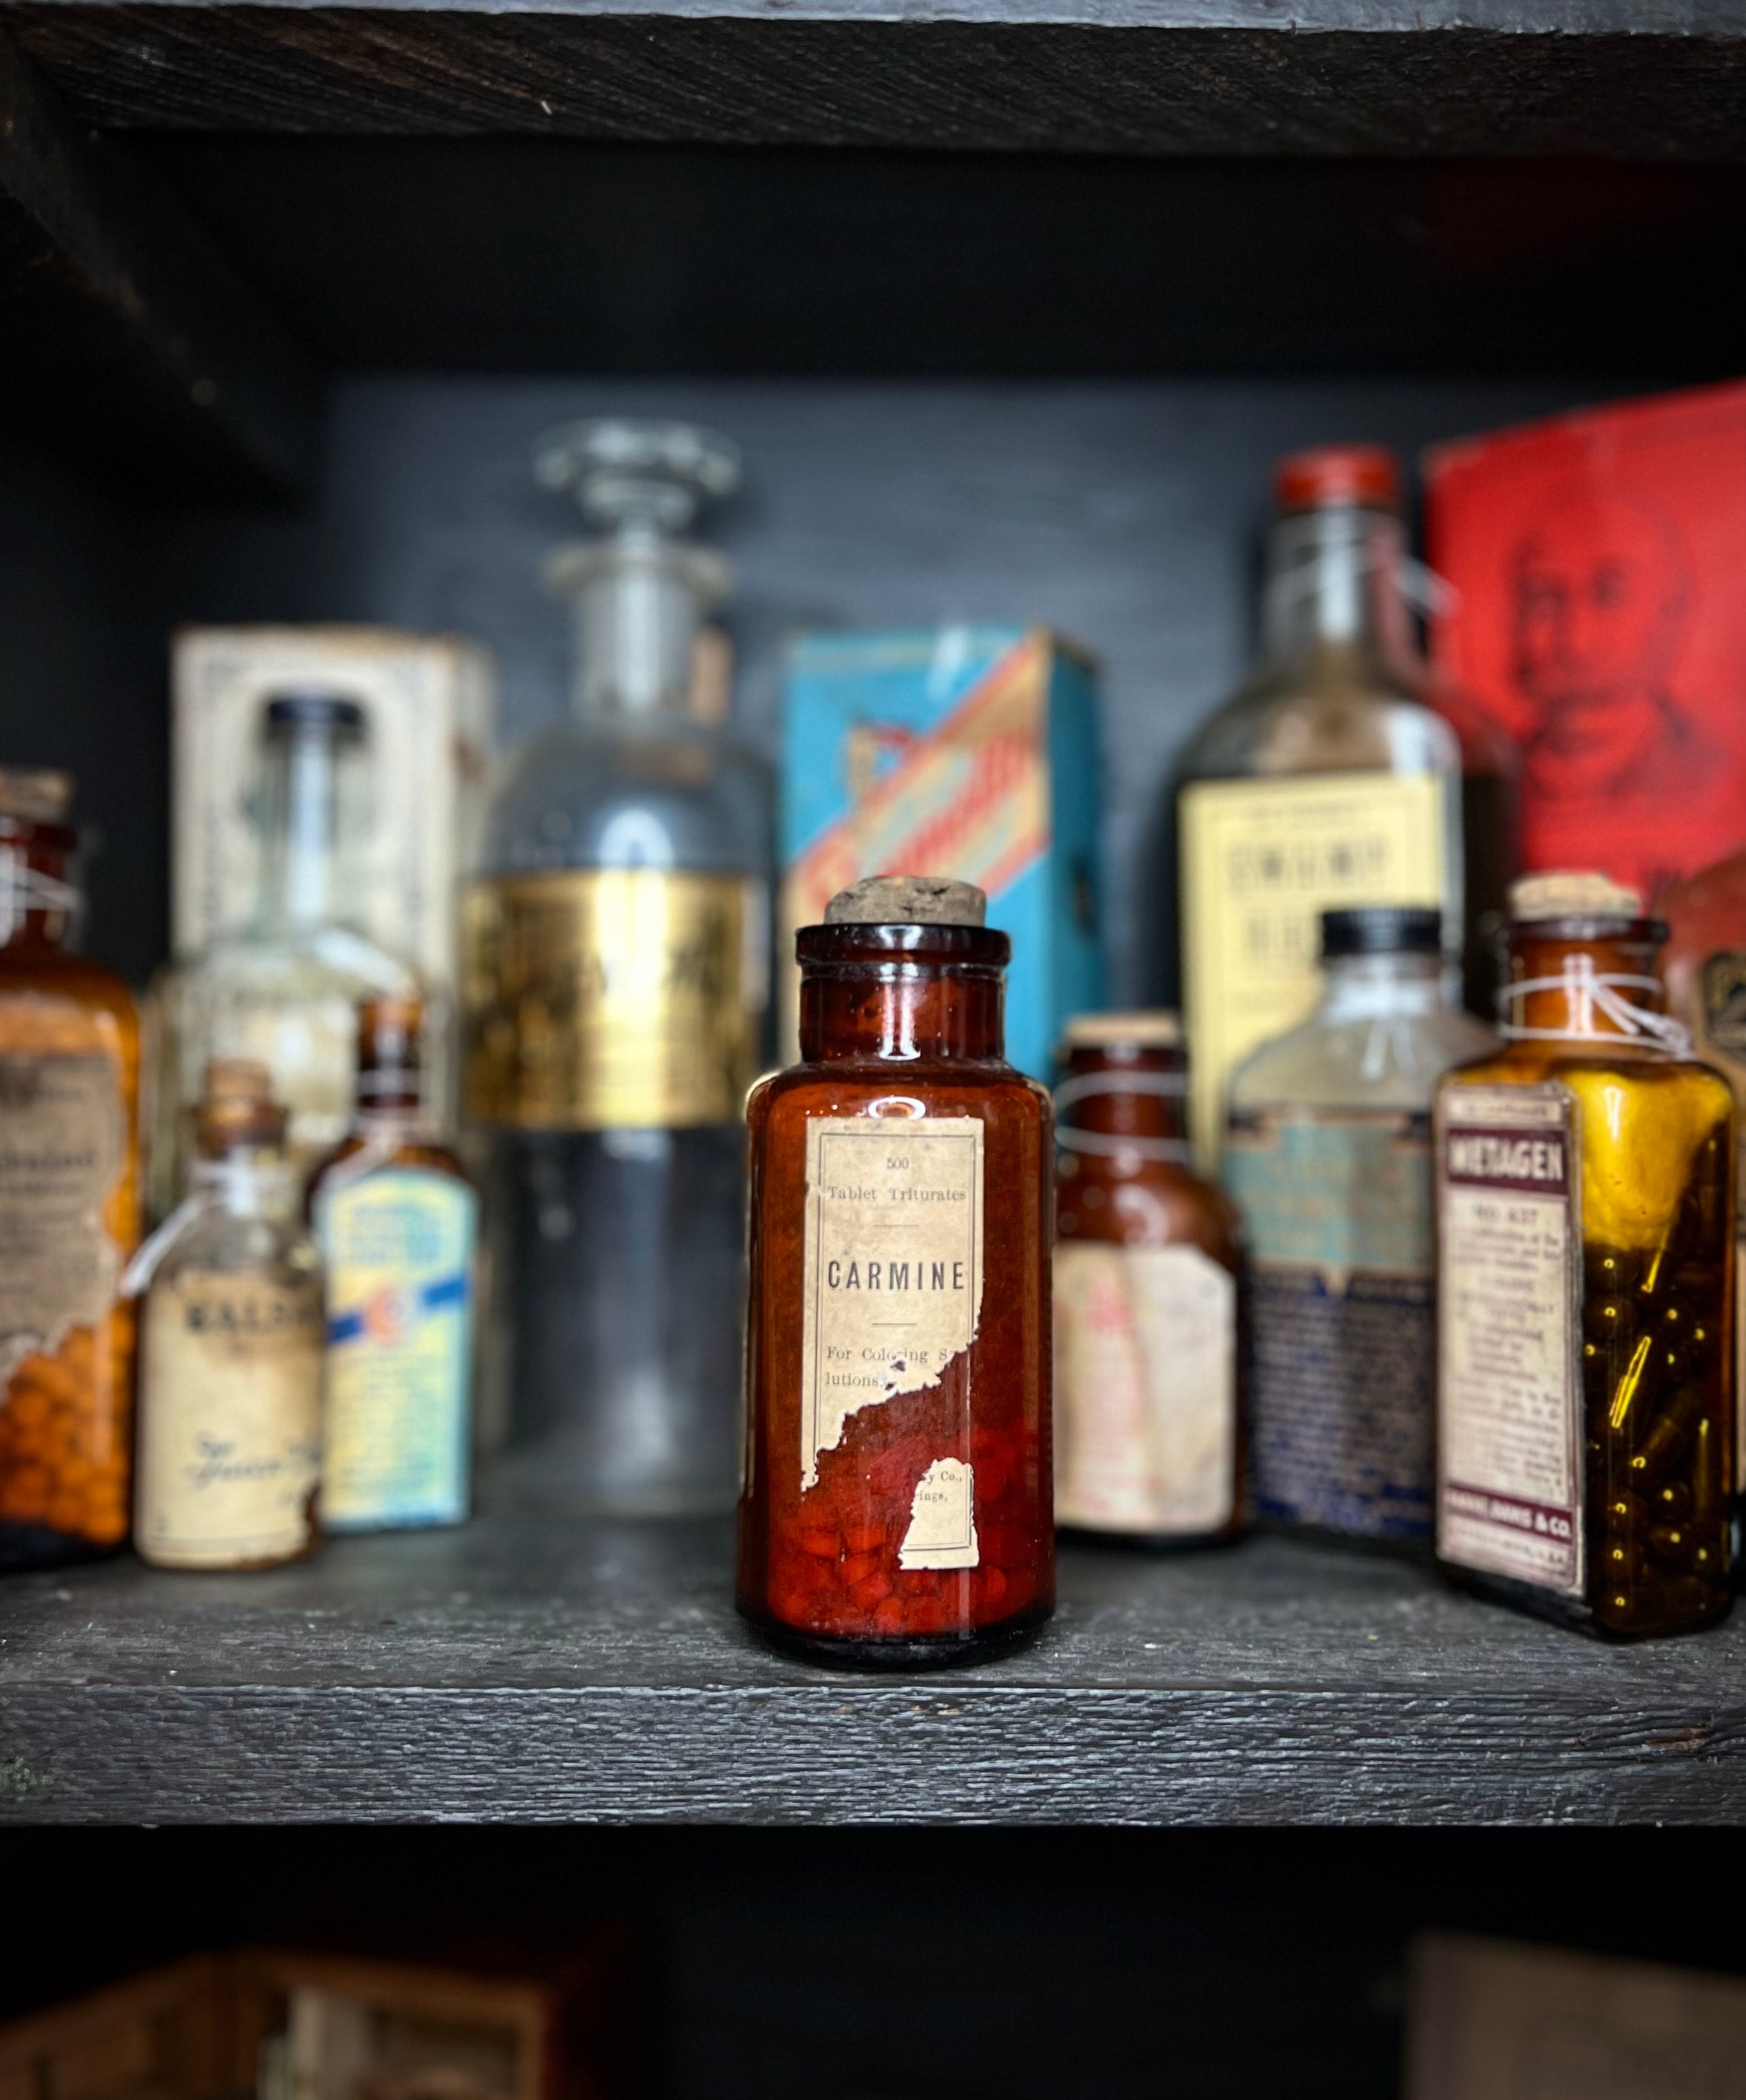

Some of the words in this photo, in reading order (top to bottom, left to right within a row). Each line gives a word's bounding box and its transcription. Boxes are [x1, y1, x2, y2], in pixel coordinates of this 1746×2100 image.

[886, 1157, 910, 1170] 500
[1450, 1137, 1564, 1182] METAGEN
[828, 1186, 877, 1200] Tablet
[889, 1187, 966, 1201] Triturates
[828, 1260, 964, 1291] CARMINE
[827, 1346, 853, 1359] For
[862, 1348, 929, 1363] Coloing
[939, 1348, 954, 1361] S
[941, 1471, 962, 1482] Co.,
[919, 1490, 948, 1503] ings,
